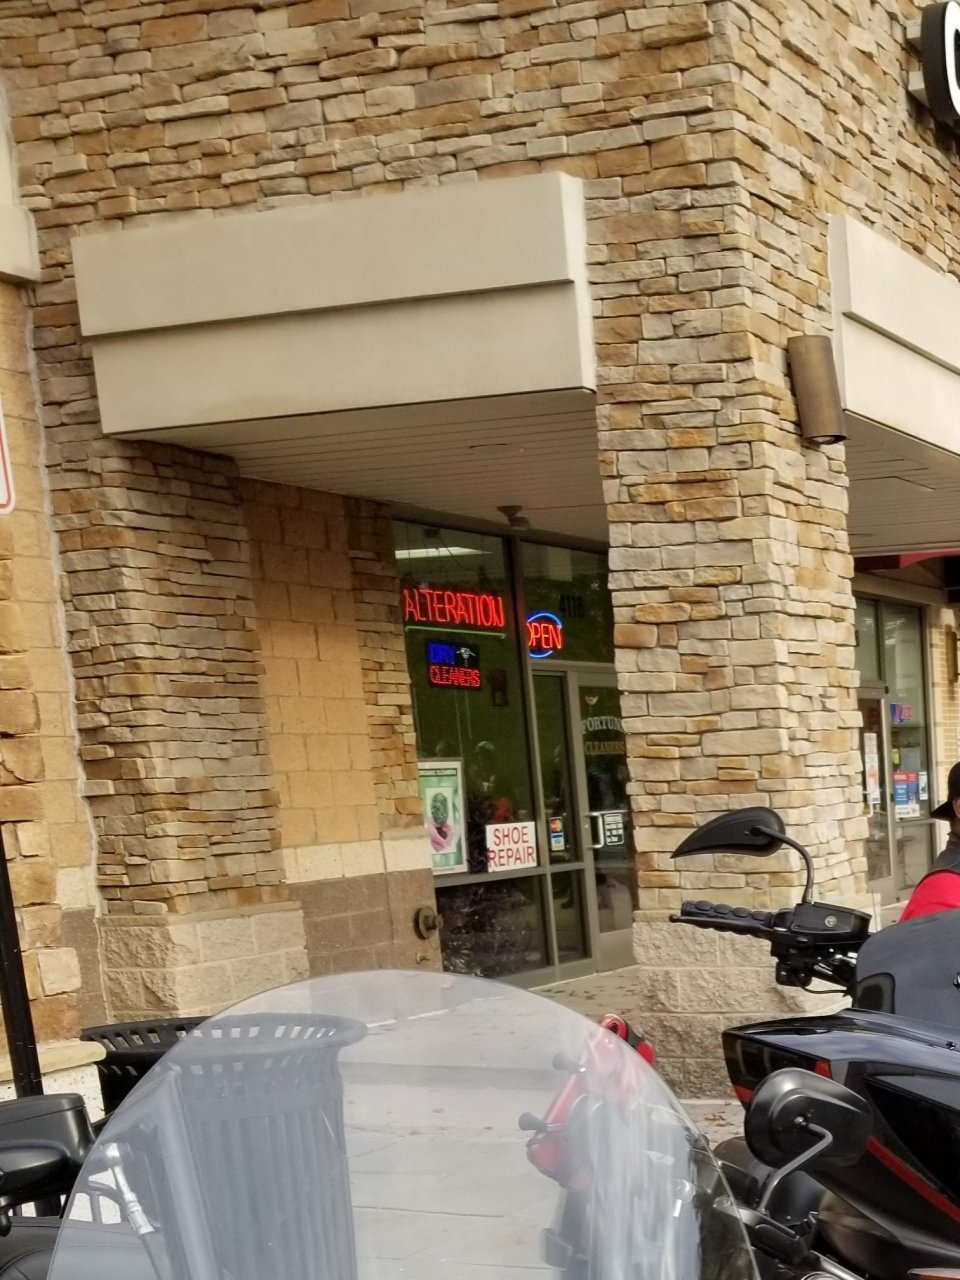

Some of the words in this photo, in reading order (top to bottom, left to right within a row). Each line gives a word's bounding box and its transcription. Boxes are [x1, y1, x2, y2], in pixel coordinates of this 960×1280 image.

[403, 588, 505, 627] ALTERATION
[429, 665, 481, 687] CLEANERS
[582, 715, 624, 734] FORTUN
[493, 826, 529, 847] SHOE
[487, 845, 536, 868] REPAIR
